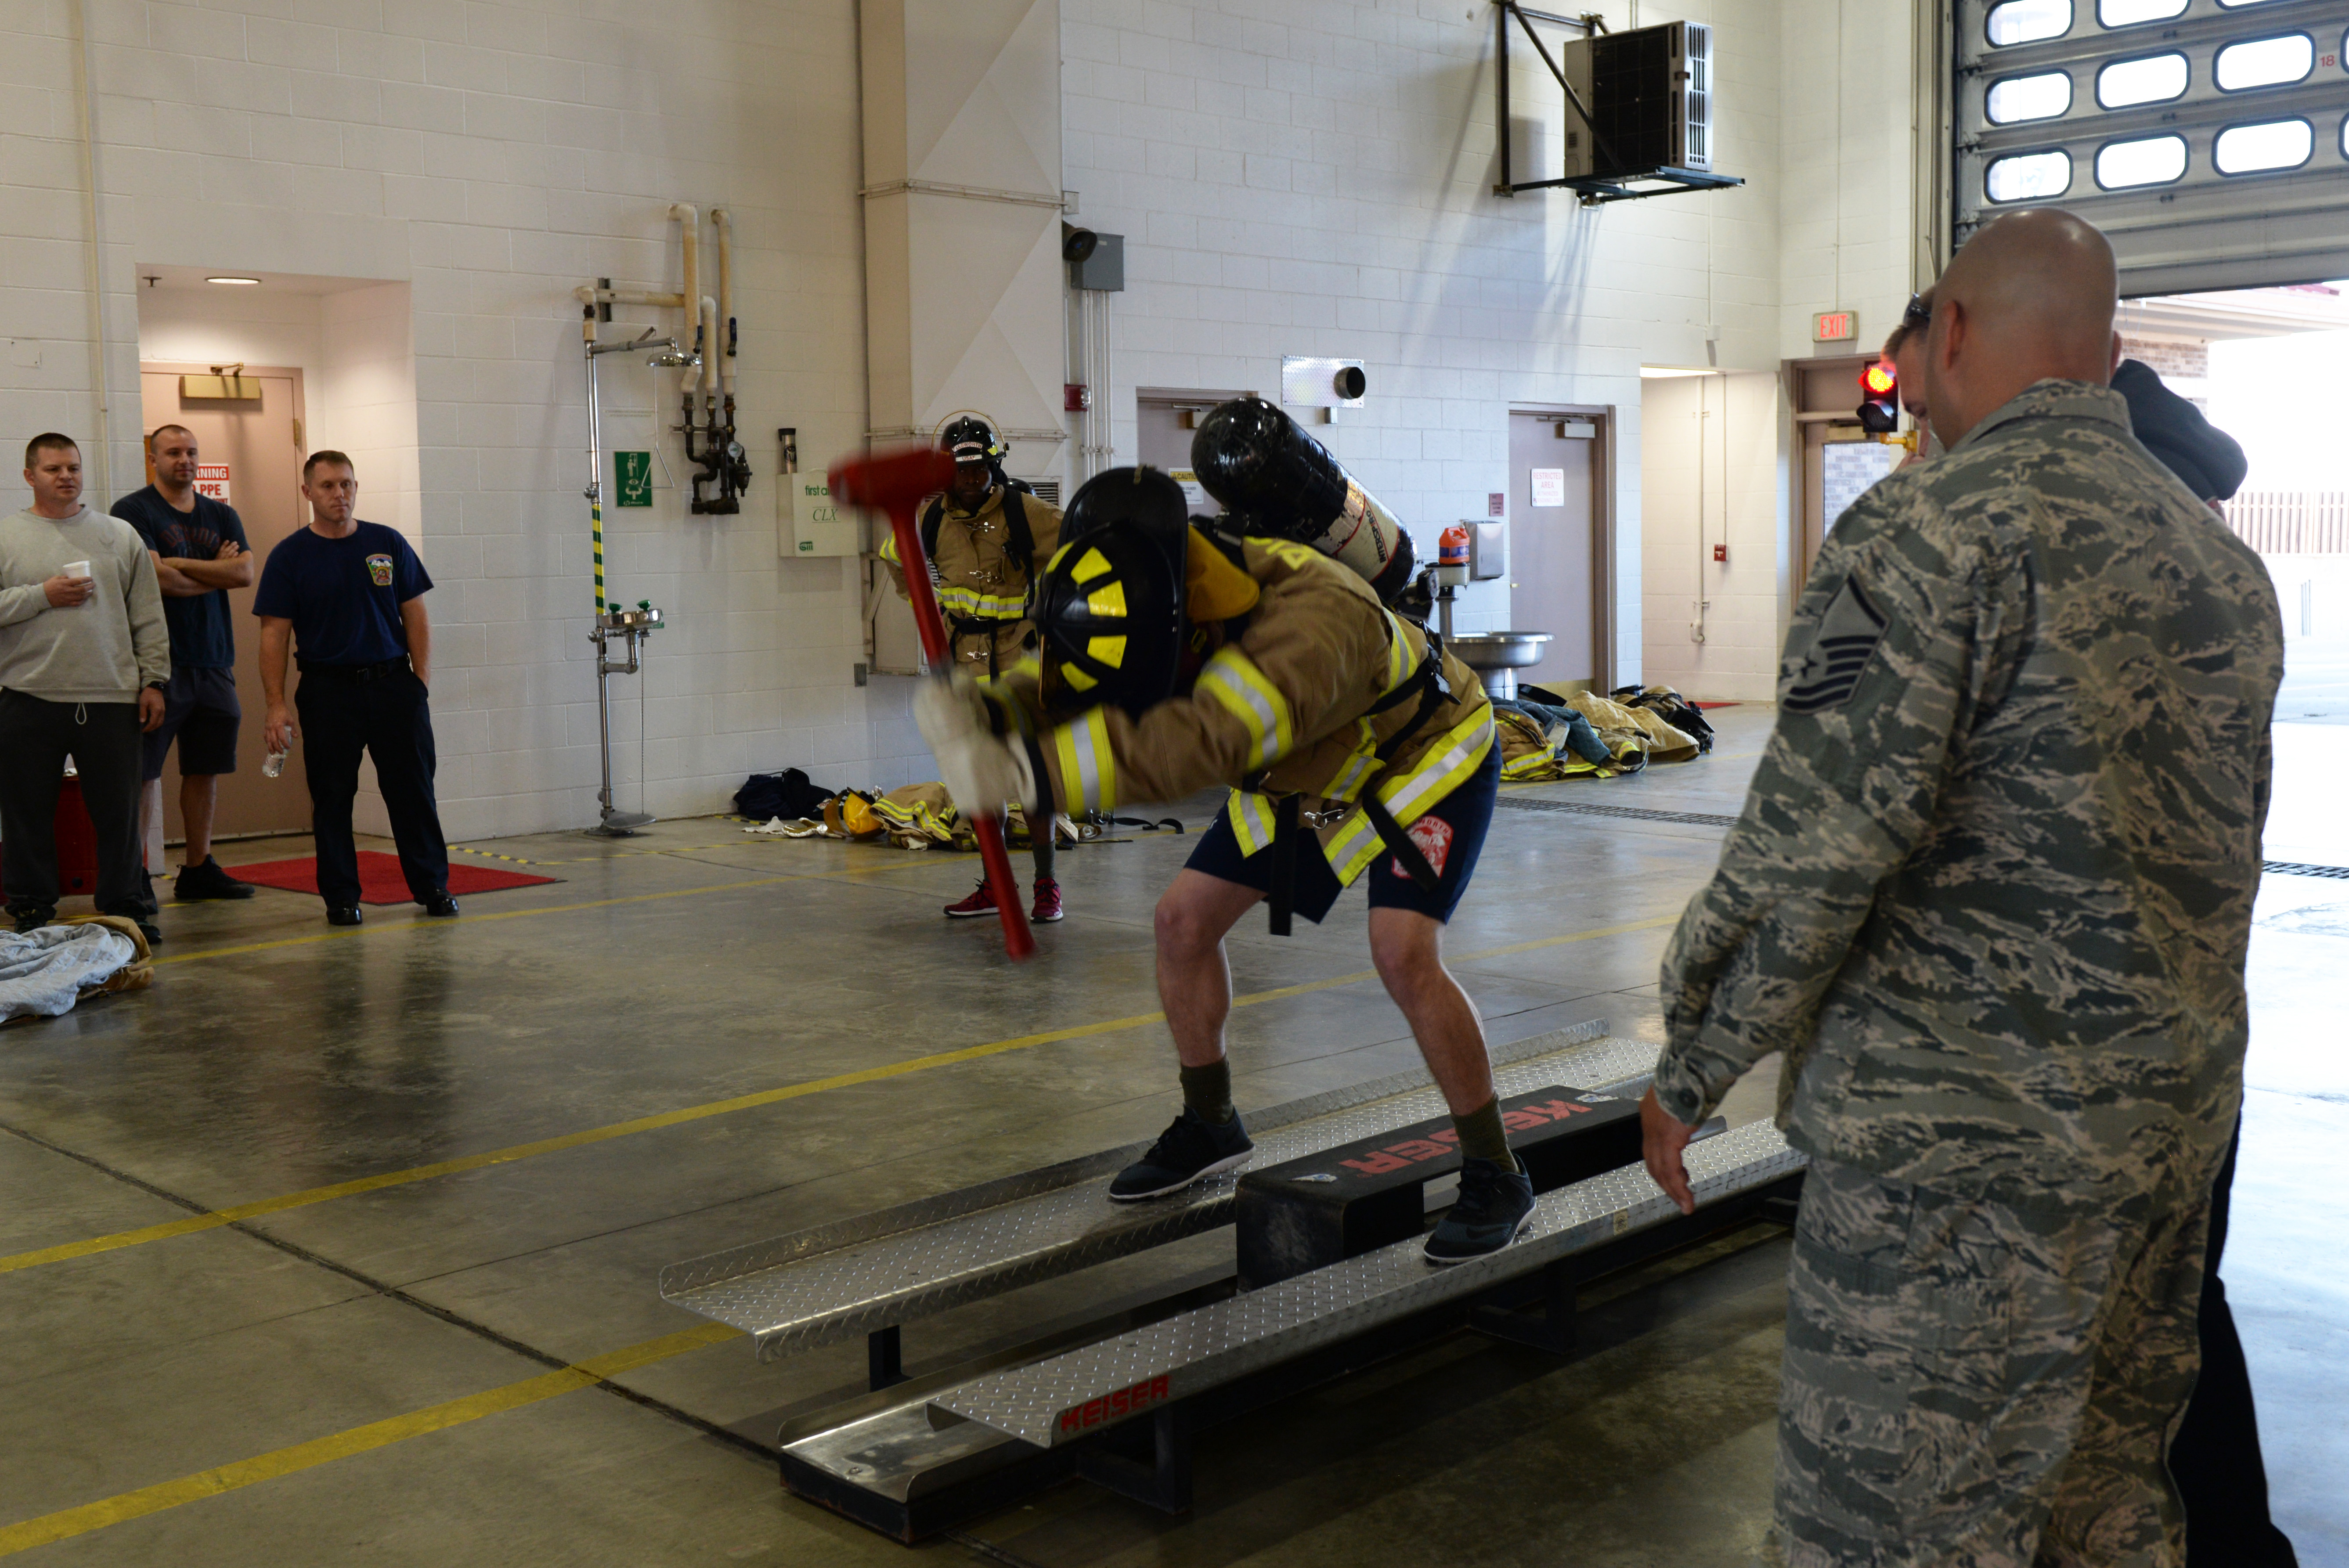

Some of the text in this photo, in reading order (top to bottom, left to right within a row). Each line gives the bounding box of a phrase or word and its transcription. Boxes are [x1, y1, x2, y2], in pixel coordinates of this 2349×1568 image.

[2320, 55, 2335, 67] 18
[1820, 314, 1848, 338] EXIT
[200, 484, 221, 496] PPE
[805, 485, 820, 496] first
[813, 508, 838, 521] CLX
[1366, 510, 1387, 563] INTERSPIRO
[1061, 1374, 1169, 1431] KEISER
